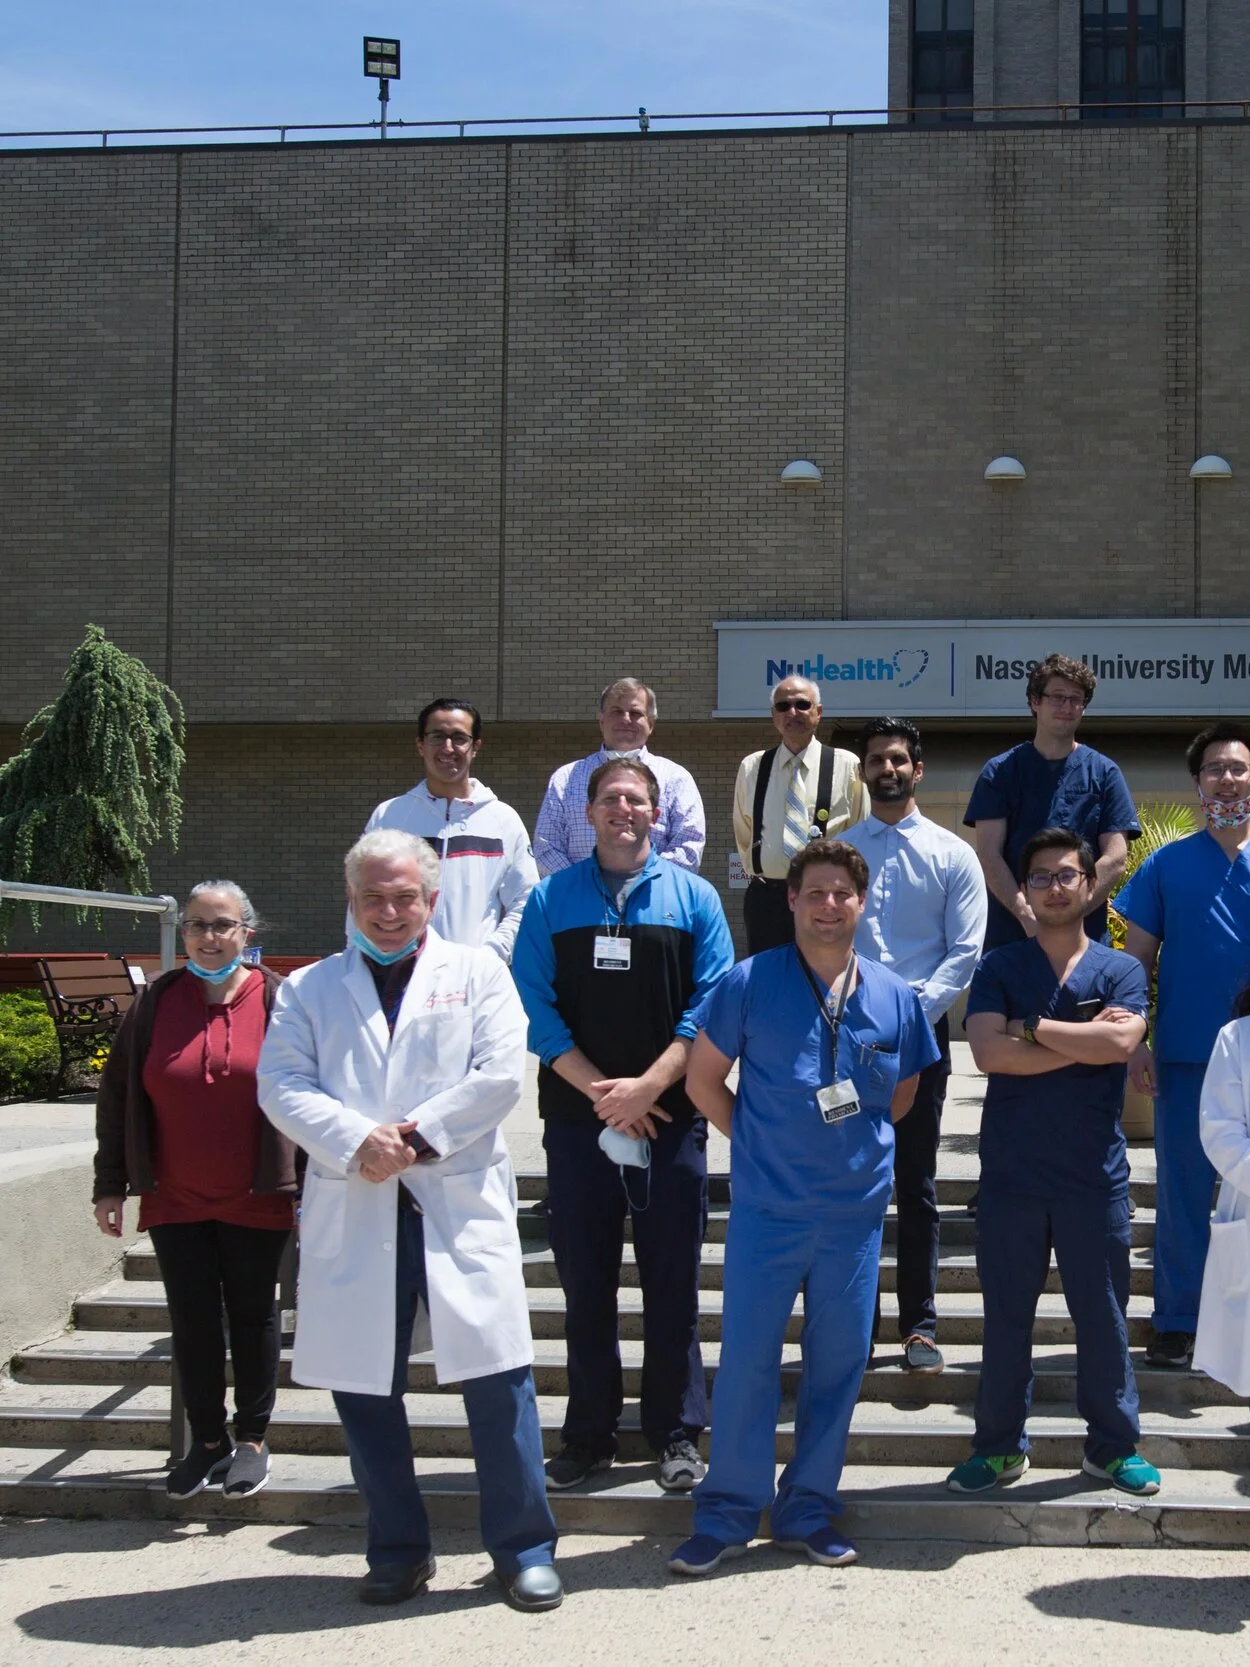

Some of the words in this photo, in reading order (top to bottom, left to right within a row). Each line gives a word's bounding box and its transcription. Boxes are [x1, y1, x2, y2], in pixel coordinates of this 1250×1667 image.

[766, 654, 894, 686] NuHealth
[975, 654, 1039, 680] Nass
[1081, 653, 1215, 684] University
